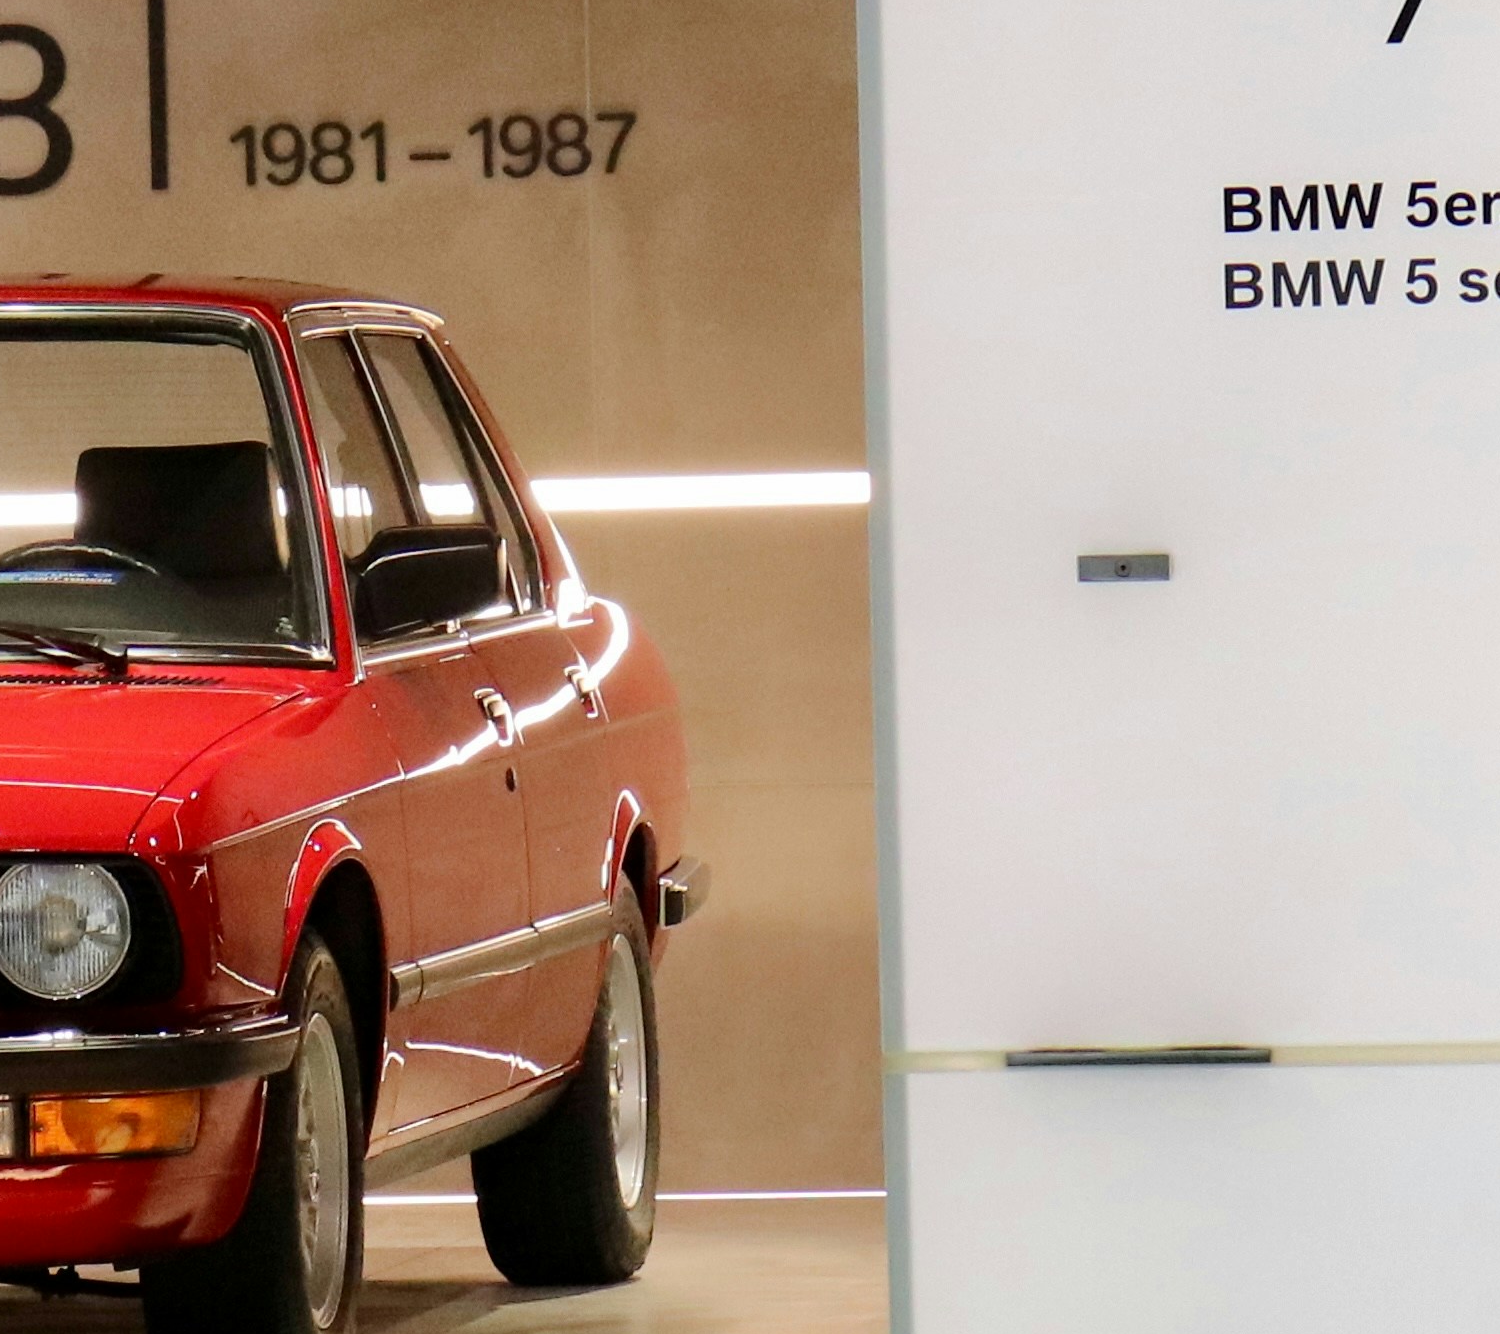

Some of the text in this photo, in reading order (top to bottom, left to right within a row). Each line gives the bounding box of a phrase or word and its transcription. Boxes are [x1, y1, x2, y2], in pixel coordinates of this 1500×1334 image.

[1223, 182, 1383, 234] BMW
[1224, 258, 1385, 310] BMW
[1405, 258, 1438, 305] 5
